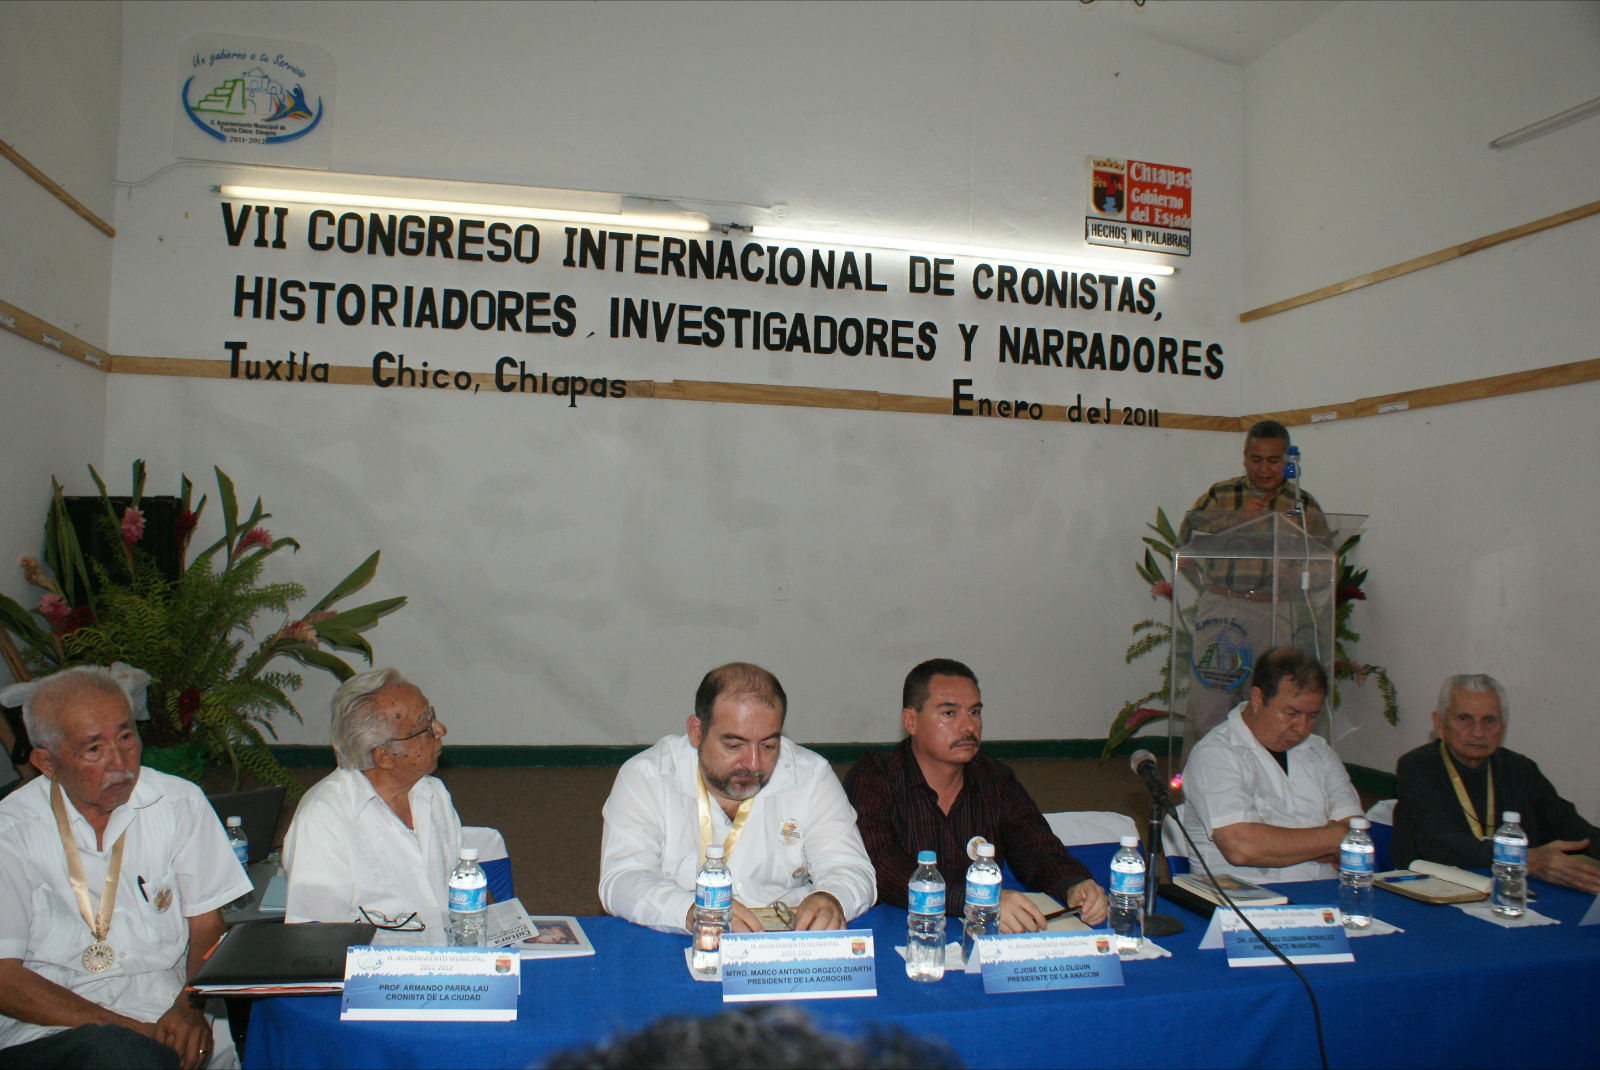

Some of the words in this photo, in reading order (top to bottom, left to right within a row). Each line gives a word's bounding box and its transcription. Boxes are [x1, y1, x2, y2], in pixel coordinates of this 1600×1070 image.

[230, 136, 266, 144] 2011-2012
[1129, 162, 1192, 190] Chiapas
[1130, 187, 1184, 210] Gobierno
[1130, 206, 1150, 224] del
[1131, 228, 1143, 243] NO
[221, 202, 288, 249] VII
[307, 209, 540, 265] CONGRESO
[562, 227, 888, 292] INTERNACIONAL
[909, 255, 955, 297] DE
[972, 263, 1162, 322] CRONISTAS,
[610, 297, 938, 362] INVESTIGADORES
[958, 323, 979, 362] Y
[999, 325, 1224, 380] NARRADORES
[224, 341, 329, 383] Tuxtla
[372, 351, 480, 395] Chico,
[495, 356, 627, 408] Chiapas
[952, 378, 1044, 421] Enero
[1067, 393, 1112, 425] del
[1120, 406, 1160, 428] 2011
[748, 976, 792, 984] PRESIDENTE
[816, 974, 852, 982] ACROCHIS
[1008, 974, 1048, 982] PRESIDENTE
[1070, 970, 1100, 979] ANACCIM
[404, 984, 443, 992] ARMANDO
[445, 984, 472, 992] PARRA
[473, 984, 489, 992] LAU
